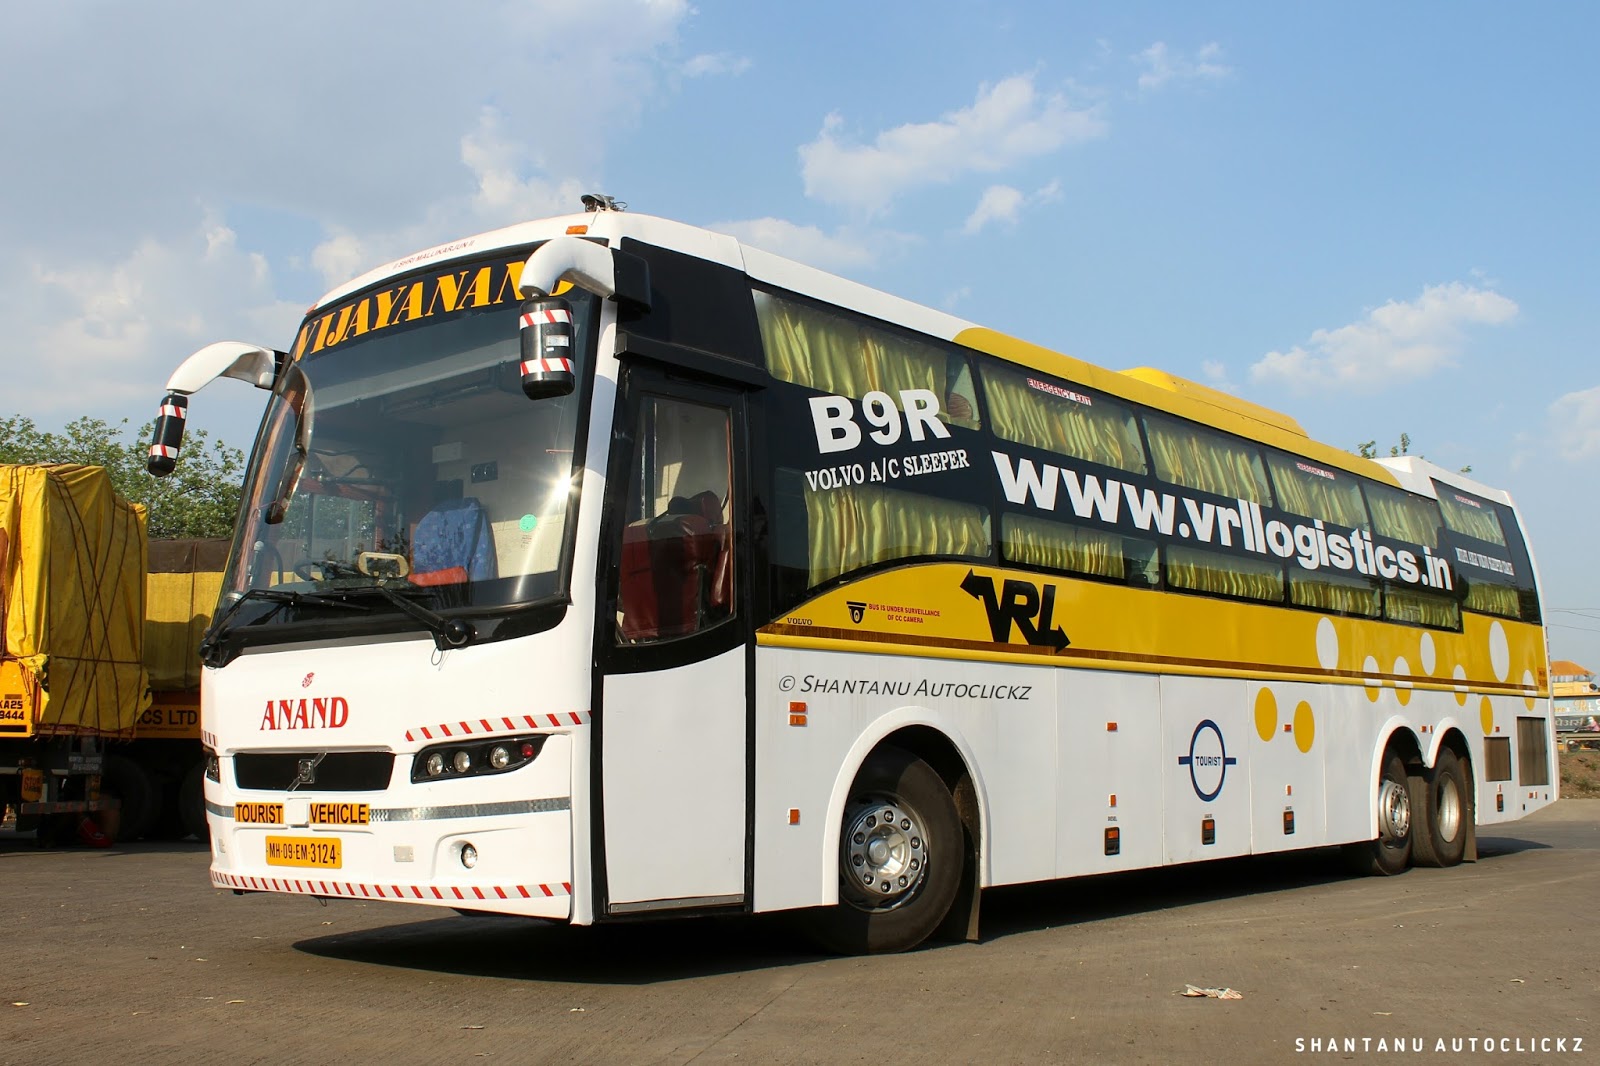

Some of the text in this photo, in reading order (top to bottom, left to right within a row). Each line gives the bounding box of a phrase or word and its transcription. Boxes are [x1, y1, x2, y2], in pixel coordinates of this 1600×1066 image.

[294, 260, 575, 361] VIJAYANAN
[1027, 378, 1092, 406] EMERGENCY EXIT
[808, 388, 951, 454] B9R
[805, 449, 970, 492] VOLVO A/C SLEEPER
[990, 450, 1453, 591] www.vrllogistics.in
[787, 617, 813, 626] VOLVO
[868, 603, 941, 617] BUS IS UNDER SURVEILLANCE
[903, 616, 924, 624] CAMERA
[960, 568, 1071, 654] VRL
[137, 709, 198, 725] CS LTD
[259, 696, 349, 731] ANAND
[1195, 756, 1222, 767] TOURIST
[236, 804, 367, 824] TOURIST VEHICLE
